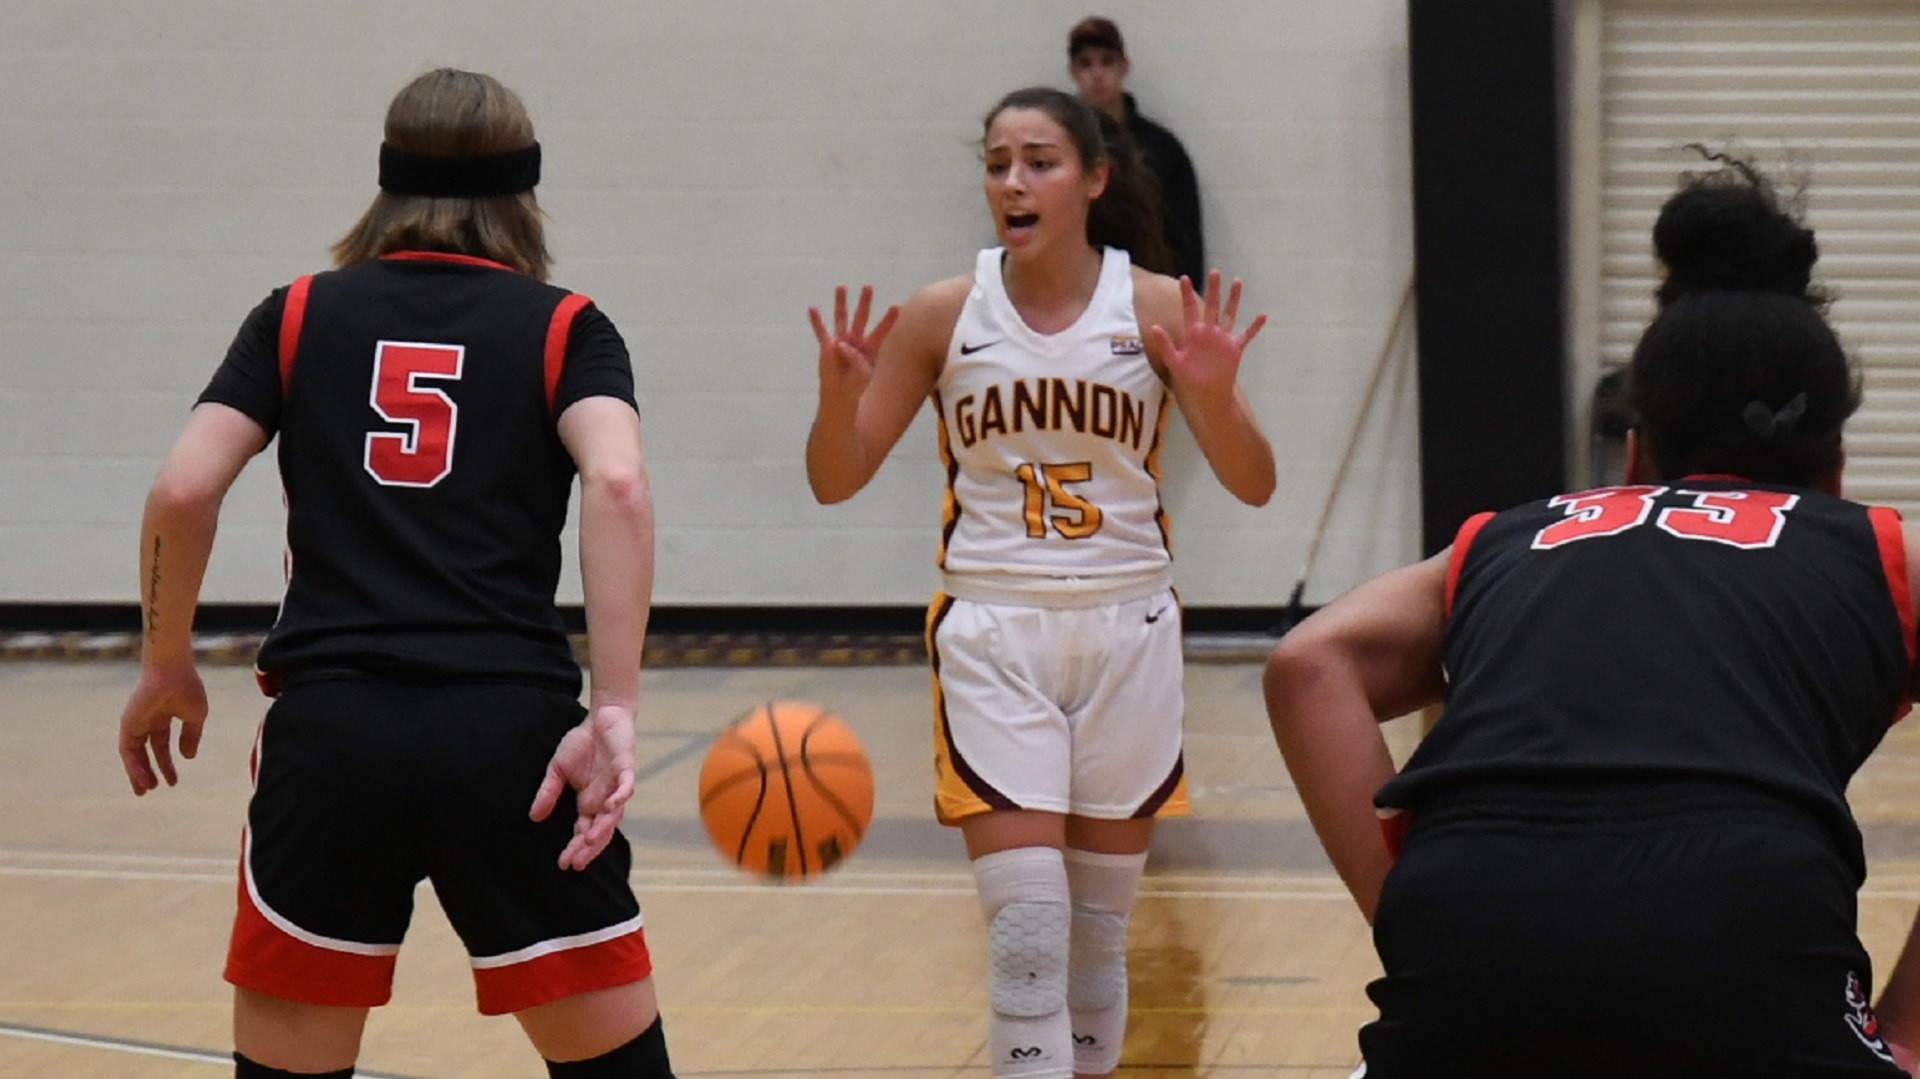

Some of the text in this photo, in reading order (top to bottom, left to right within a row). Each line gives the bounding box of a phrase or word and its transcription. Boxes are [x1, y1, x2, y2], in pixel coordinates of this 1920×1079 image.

[364, 340, 465, 488] 5
[955, 377, 1145, 449] GANNON
[1014, 462, 1103, 540] 15
[1530, 485, 1801, 550] 33
